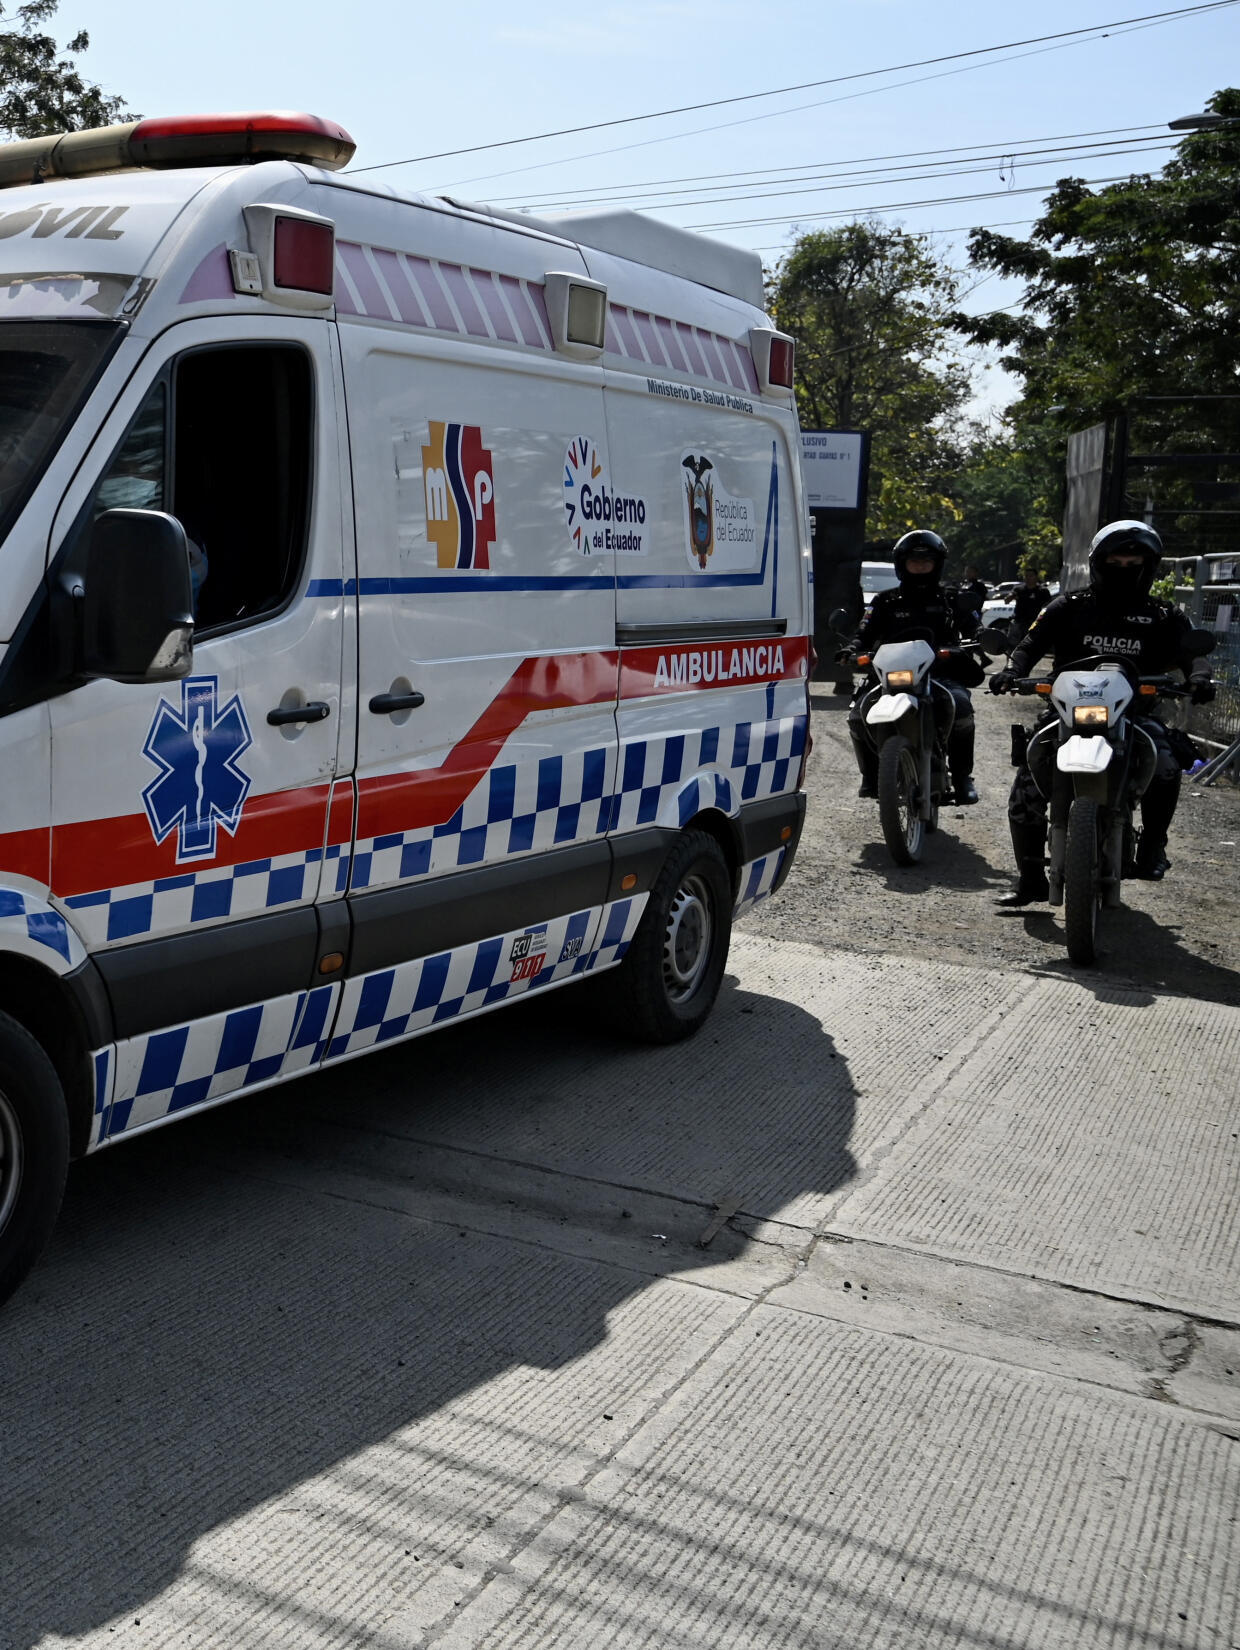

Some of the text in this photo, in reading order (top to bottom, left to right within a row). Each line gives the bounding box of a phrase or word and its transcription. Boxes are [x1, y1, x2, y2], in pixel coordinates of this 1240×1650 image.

[647, 379, 753, 414] Ministerio De Salud Publica
[801, 437, 827, 447] LUSIVO
[580, 484, 646, 525] Gobierno
[716, 499, 747, 520] República
[592, 529, 642, 551] del Ecuador
[717, 523, 755, 542] del Ecuador
[1083, 635, 1142, 650] POLICIA
[653, 645, 785, 688] AMBULANCIA
[512, 936, 532, 958] ECU
[513, 956, 543, 980] 911
